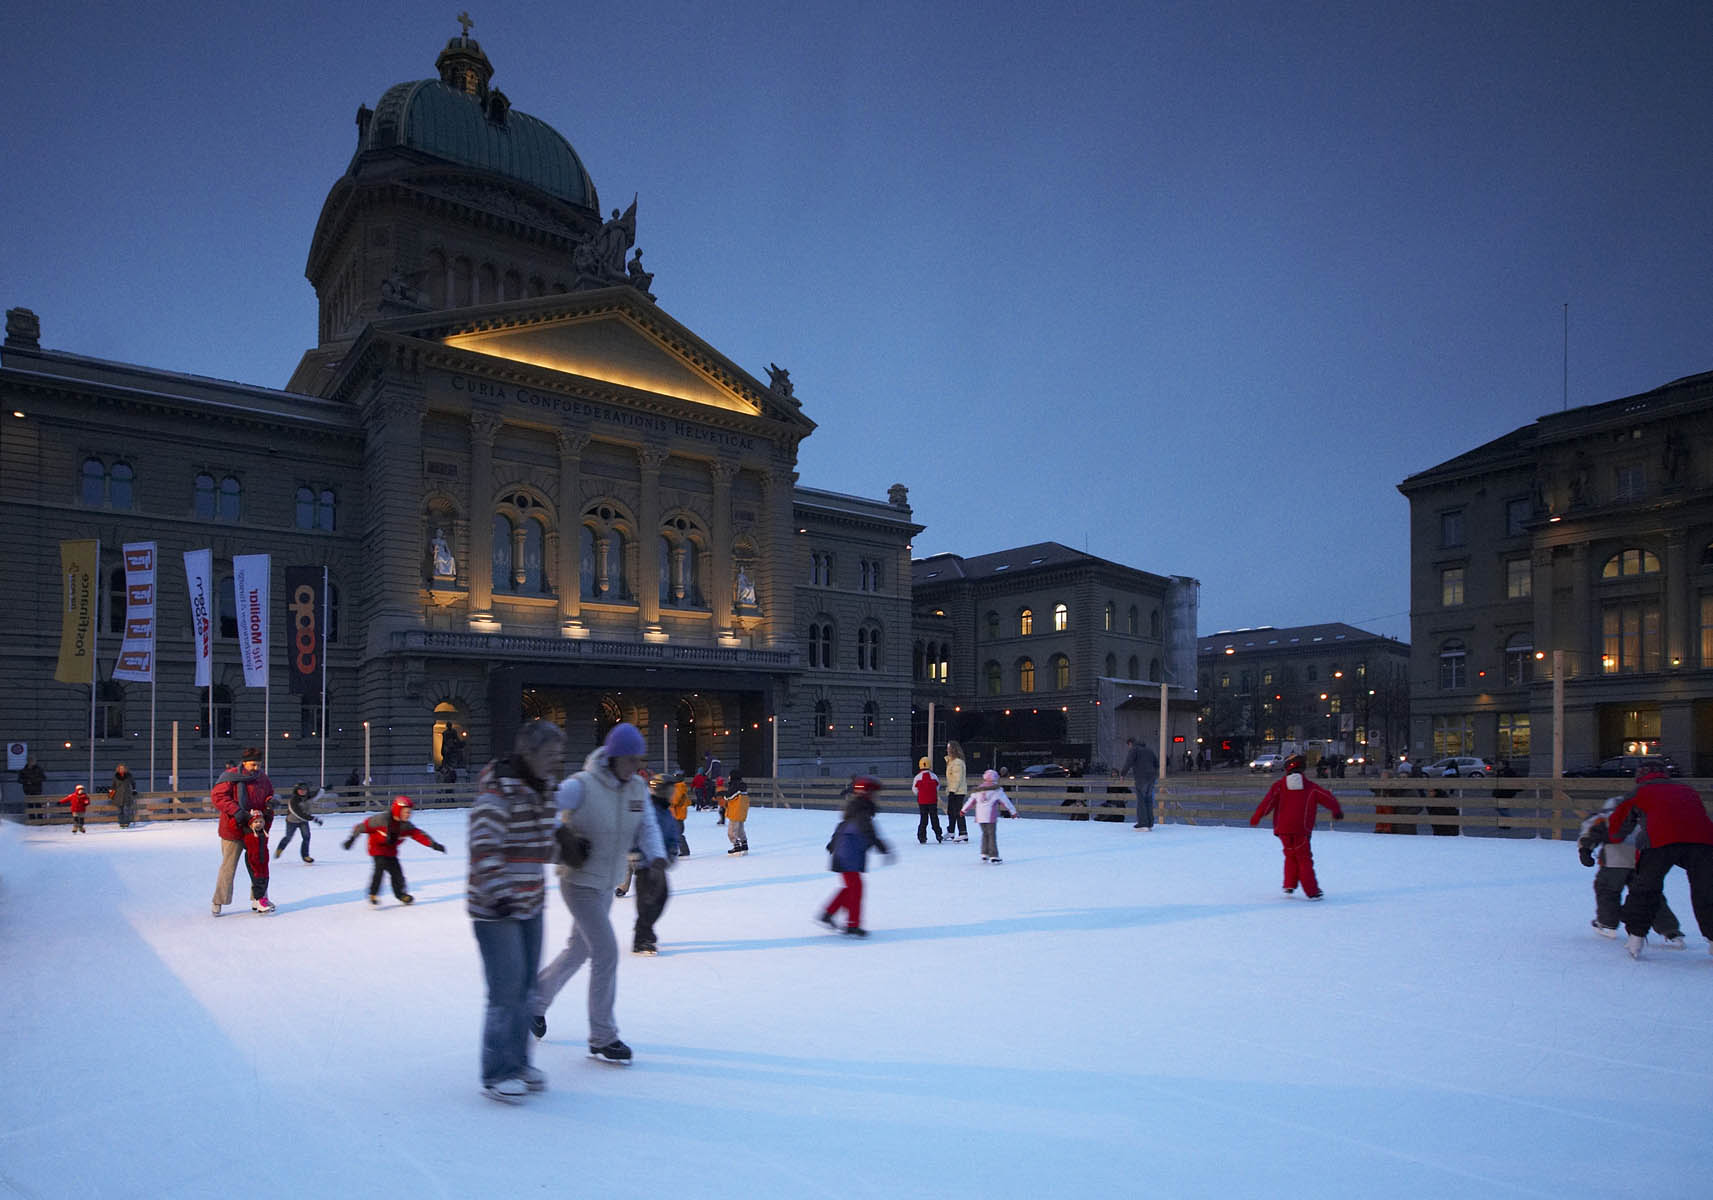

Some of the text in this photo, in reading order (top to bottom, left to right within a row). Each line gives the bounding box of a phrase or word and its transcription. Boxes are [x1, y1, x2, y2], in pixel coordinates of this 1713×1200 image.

[451, 376, 755, 450] CURIA CONFOEDERATIONIS HELVETICAE
